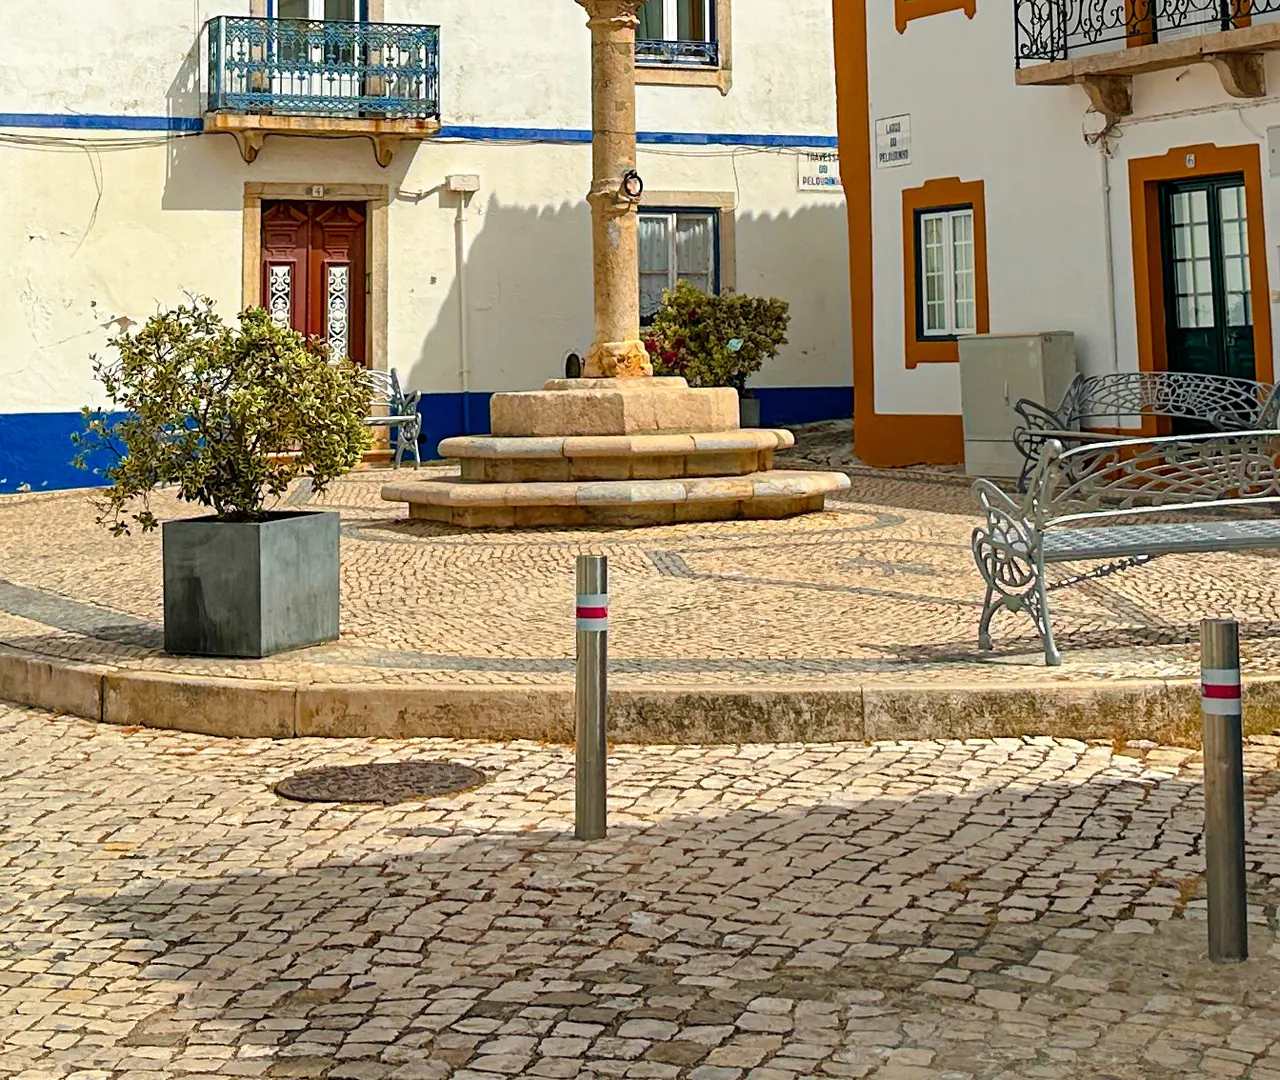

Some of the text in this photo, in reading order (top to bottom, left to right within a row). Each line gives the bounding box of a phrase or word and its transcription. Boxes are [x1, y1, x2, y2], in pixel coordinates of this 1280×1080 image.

[886, 122, 901, 134] LARGO
[890, 137, 897, 147] DO
[879, 149, 909, 163] PELOURINHO
[819, 164, 828, 174] DO
